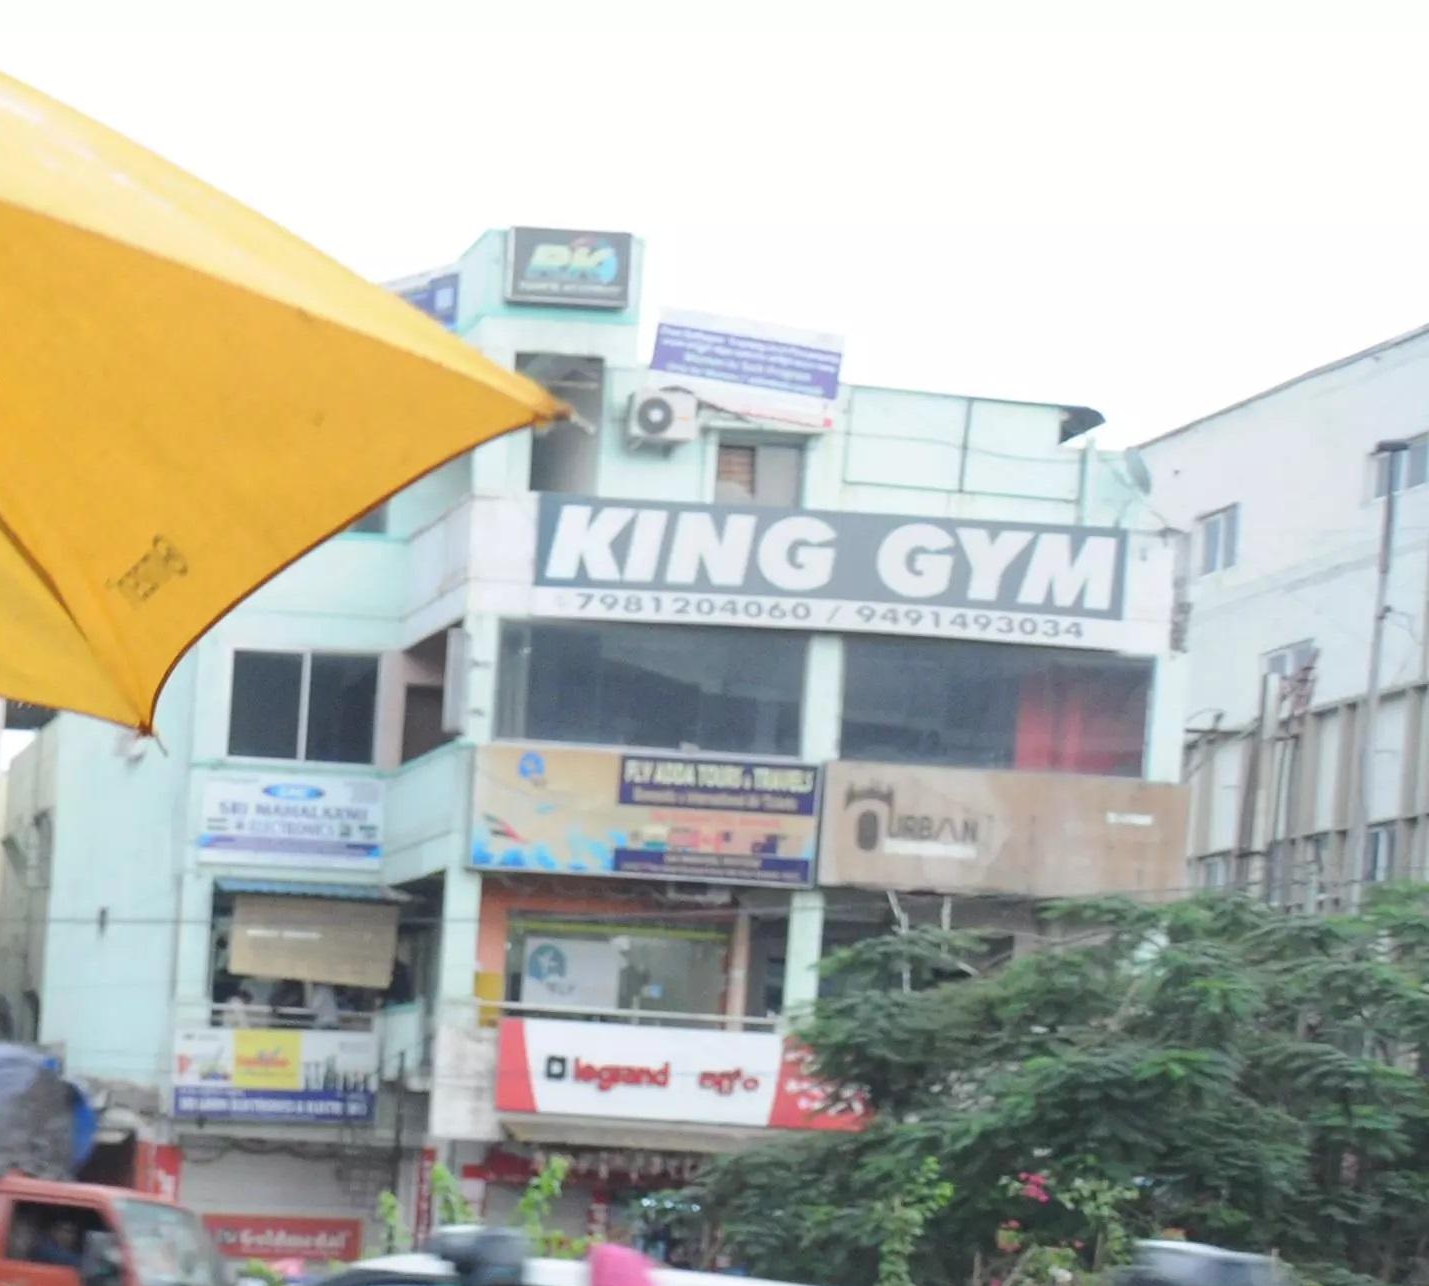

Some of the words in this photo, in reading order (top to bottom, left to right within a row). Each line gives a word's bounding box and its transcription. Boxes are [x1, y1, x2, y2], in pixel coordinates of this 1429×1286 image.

[545, 504, 838, 591] KING
[876, 515, 1120, 611] GYM
[577, 593, 812, 621] 7981204060
[855, 604, 1085, 640] 9491493034
